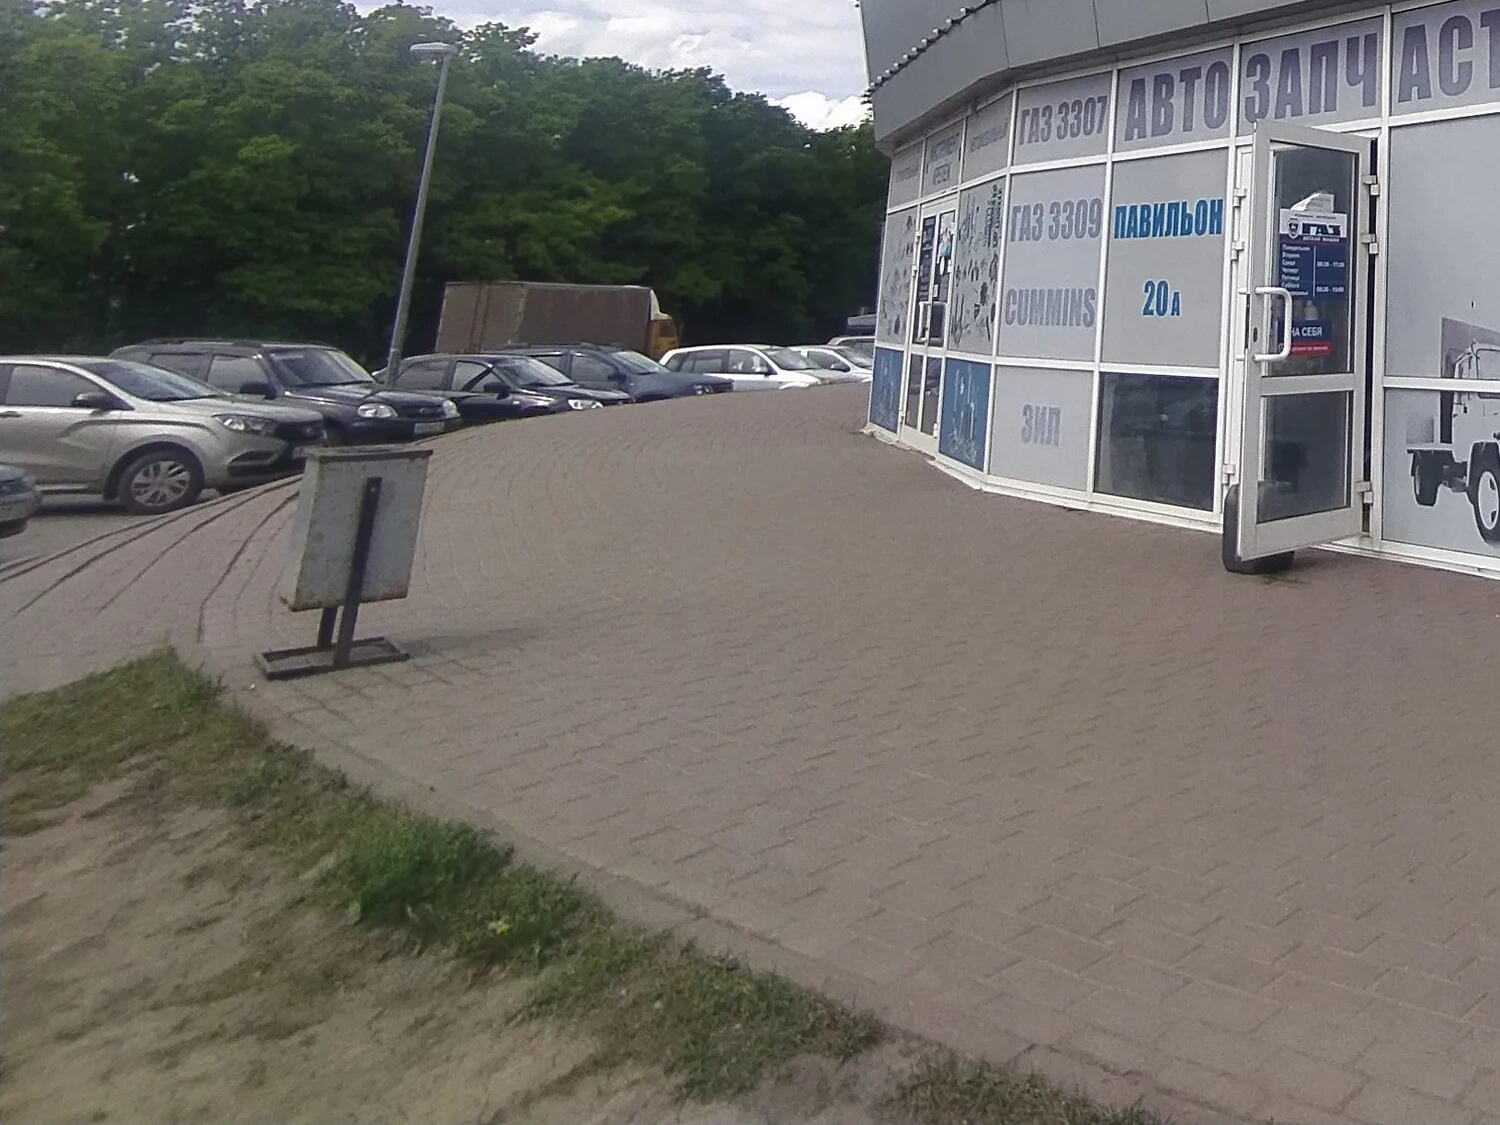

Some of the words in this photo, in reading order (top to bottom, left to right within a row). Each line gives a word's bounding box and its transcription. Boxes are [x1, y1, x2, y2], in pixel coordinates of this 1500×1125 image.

[1019, 104, 1053, 146] ГАЗ
[1056, 95, 1108, 140] 3307
[1010, 203, 1044, 242] ГАЗ
[1049, 198, 1102, 240] 3309
[1114, 198, 1223, 239] ПАВИЛЬОН
[1005, 288, 1096, 327] CUMMINS
[1301, 326, 1323, 337] СЕБЯ
